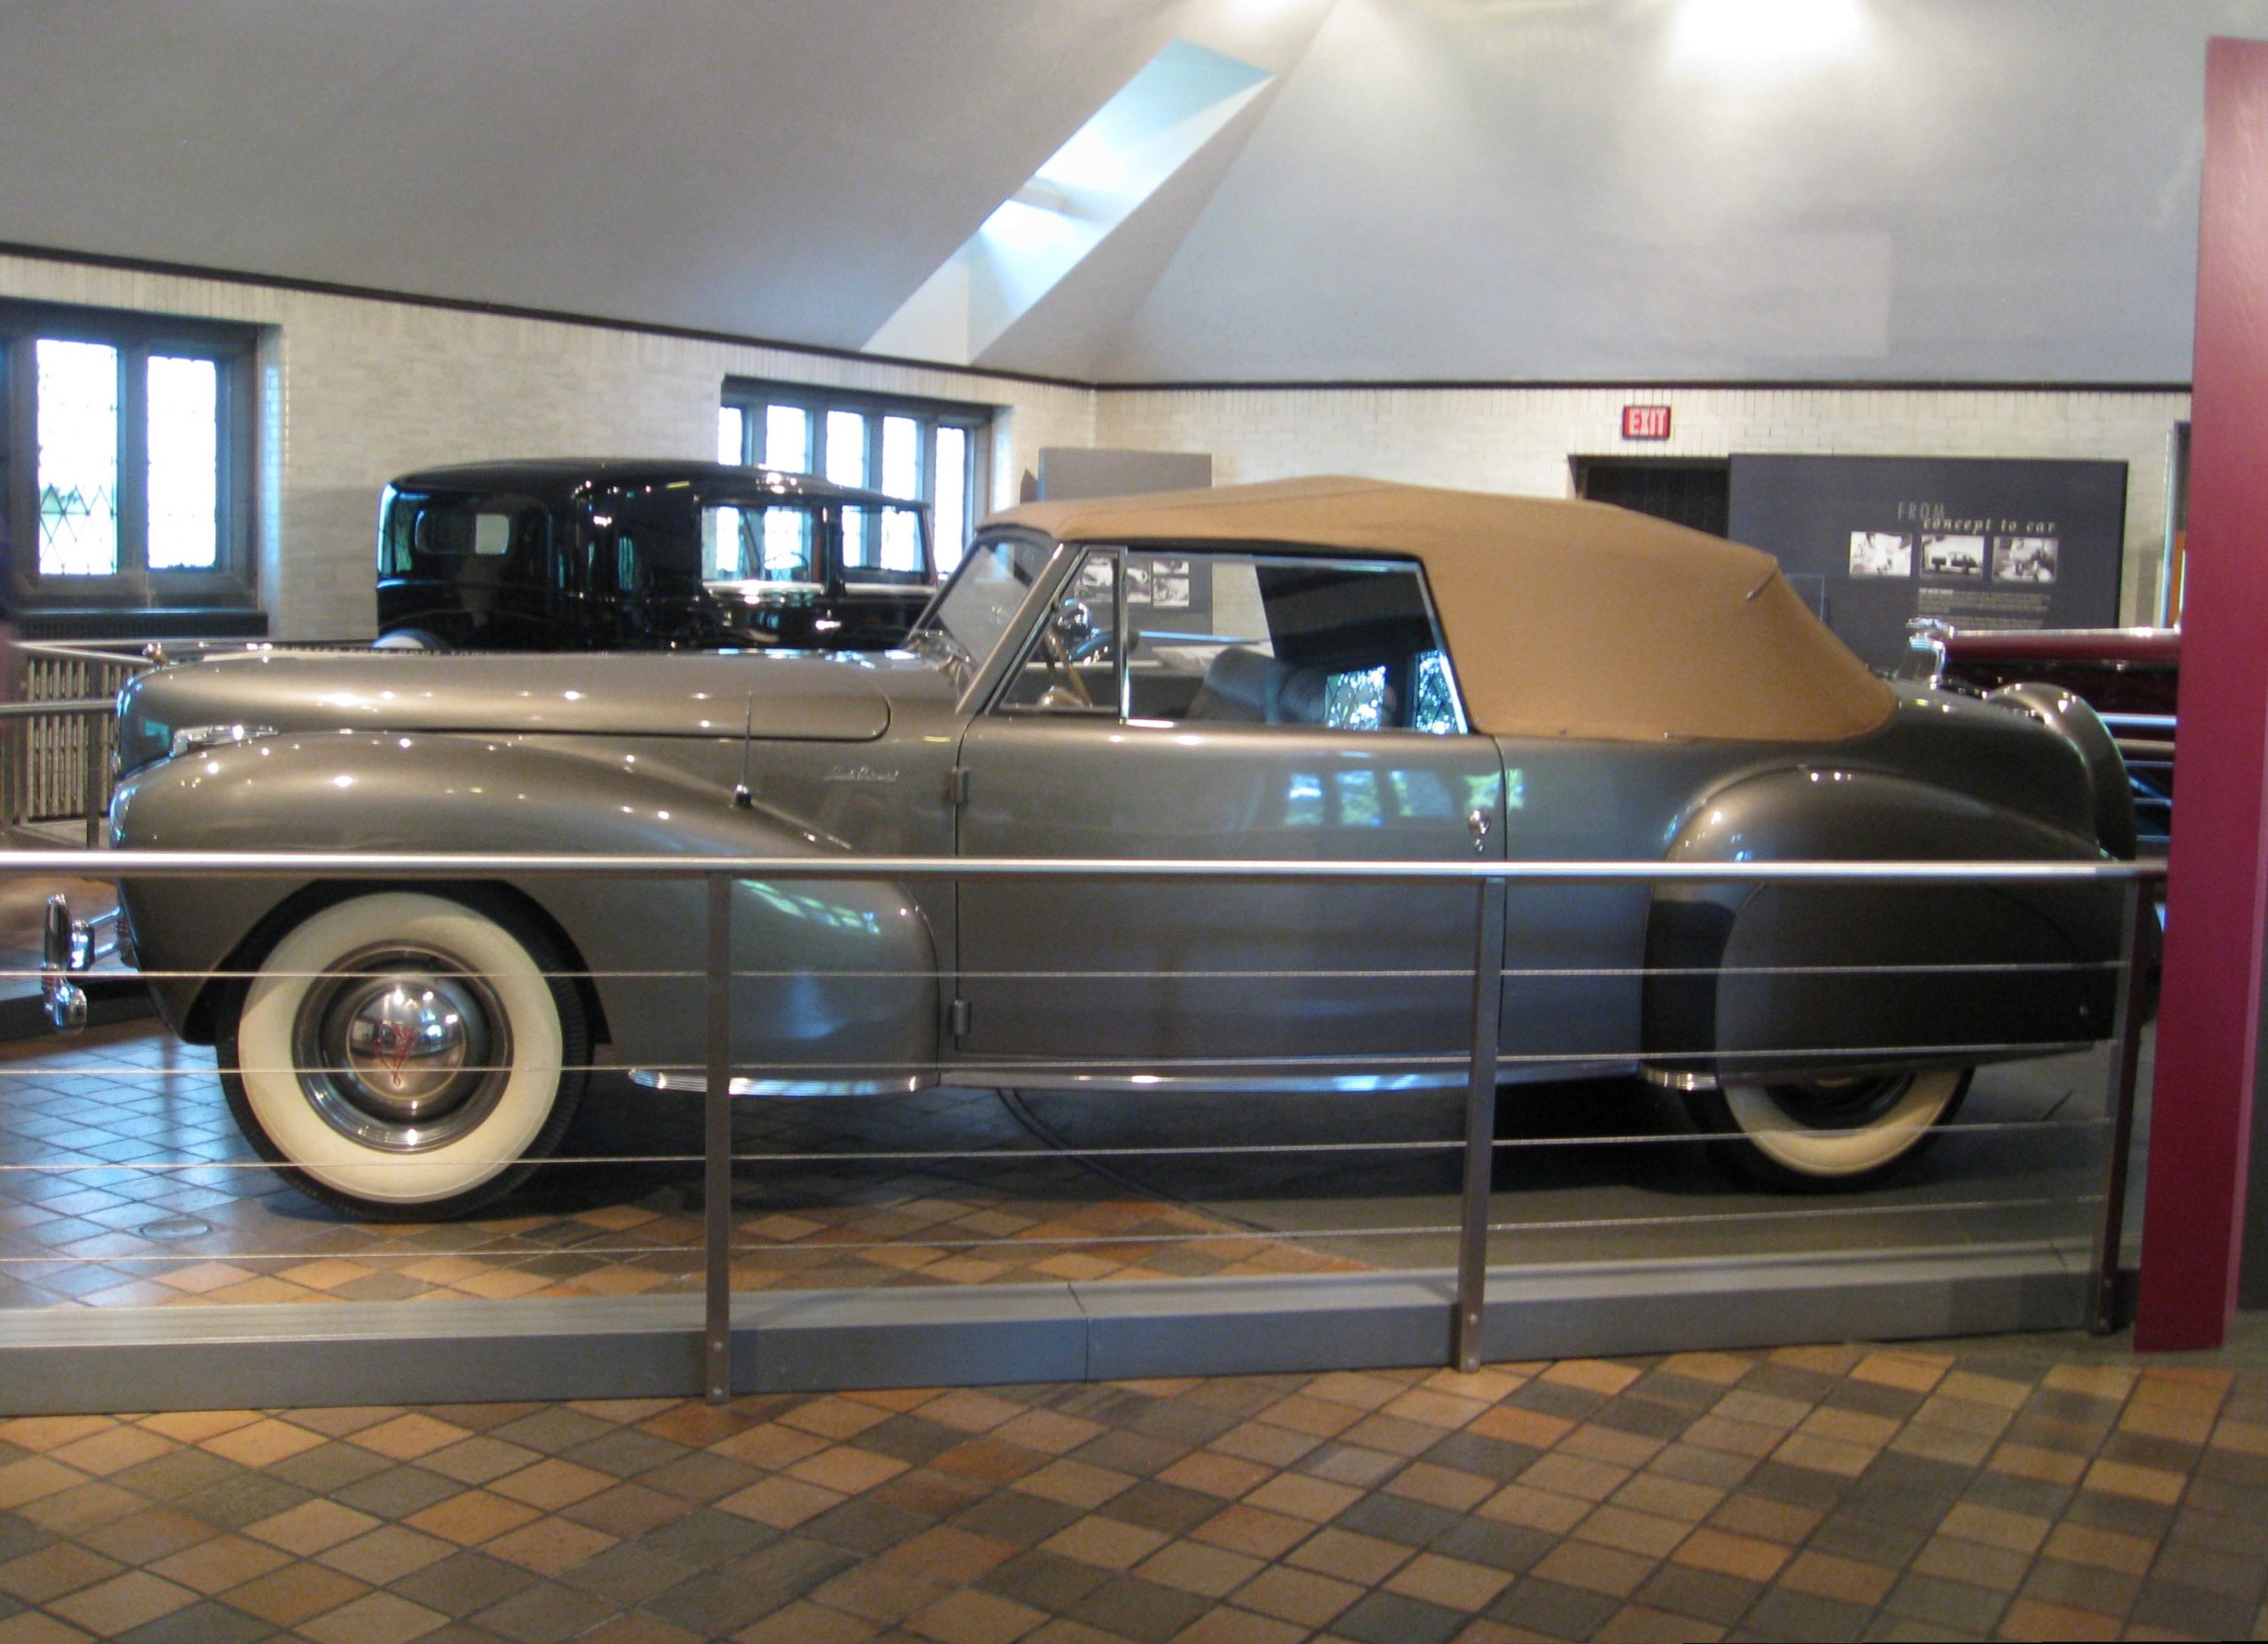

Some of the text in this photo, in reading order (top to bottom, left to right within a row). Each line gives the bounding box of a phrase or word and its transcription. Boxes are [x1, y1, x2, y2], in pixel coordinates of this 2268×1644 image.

[1628, 407, 1667, 437] EXIT
[1898, 501, 1946, 521] FROM
[1923, 517, 2056, 534] concept to car
